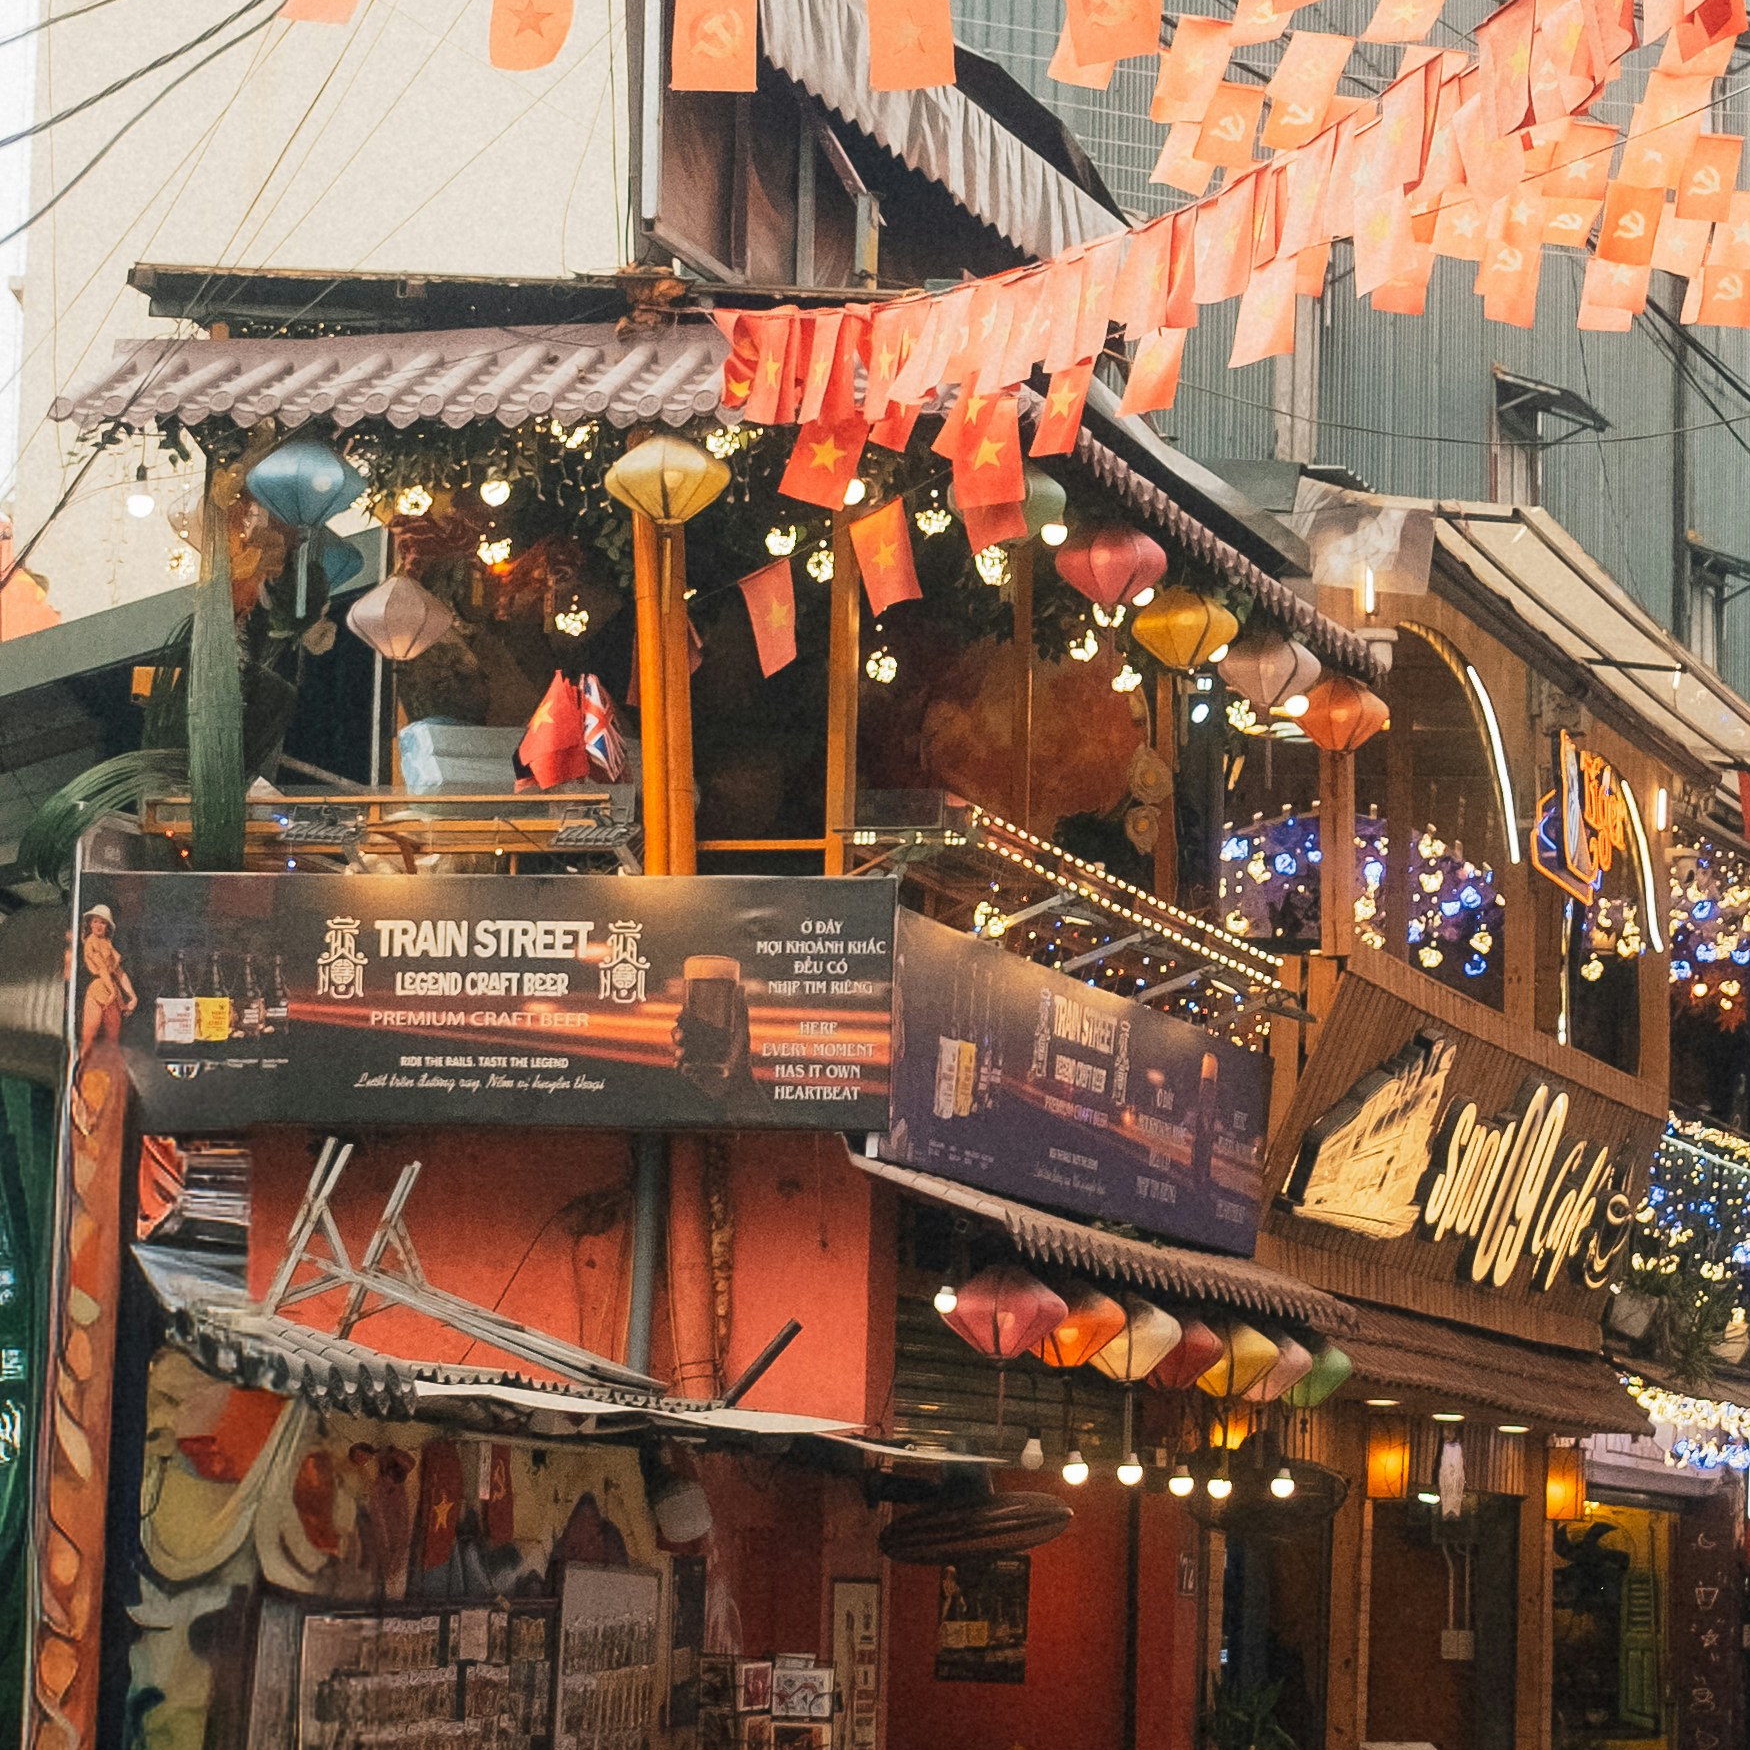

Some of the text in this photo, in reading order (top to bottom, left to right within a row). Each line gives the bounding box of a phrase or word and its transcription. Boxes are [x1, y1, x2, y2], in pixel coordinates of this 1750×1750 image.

[815, 918, 844, 934] ĐÂY
[374, 920, 594, 958] TRAIN STREET
[756, 937, 887, 956] MỌI KHOẢNH KHÁC
[826, 958, 849, 974] CÓ
[396, 971, 569, 997] LEGEND CRAFT BEER
[768, 978, 873, 996] NHỊP TIM RIÊNG
[371, 1011, 589, 1028] PREMIUM CRAFT BEER
[762, 1043, 875, 1058] EVERY MOMENT
[400, 1056, 423, 1067] RIDE
[424, 1056, 443, 1067] THE
[478, 1056, 507, 1067] TASTE
[510, 1056, 528, 1068] THE
[531, 1057, 569, 1068] LEGEND
[775, 1064, 861, 1079] HAS IT OWN
[773, 1085, 861, 1101] HEARTBEAT
